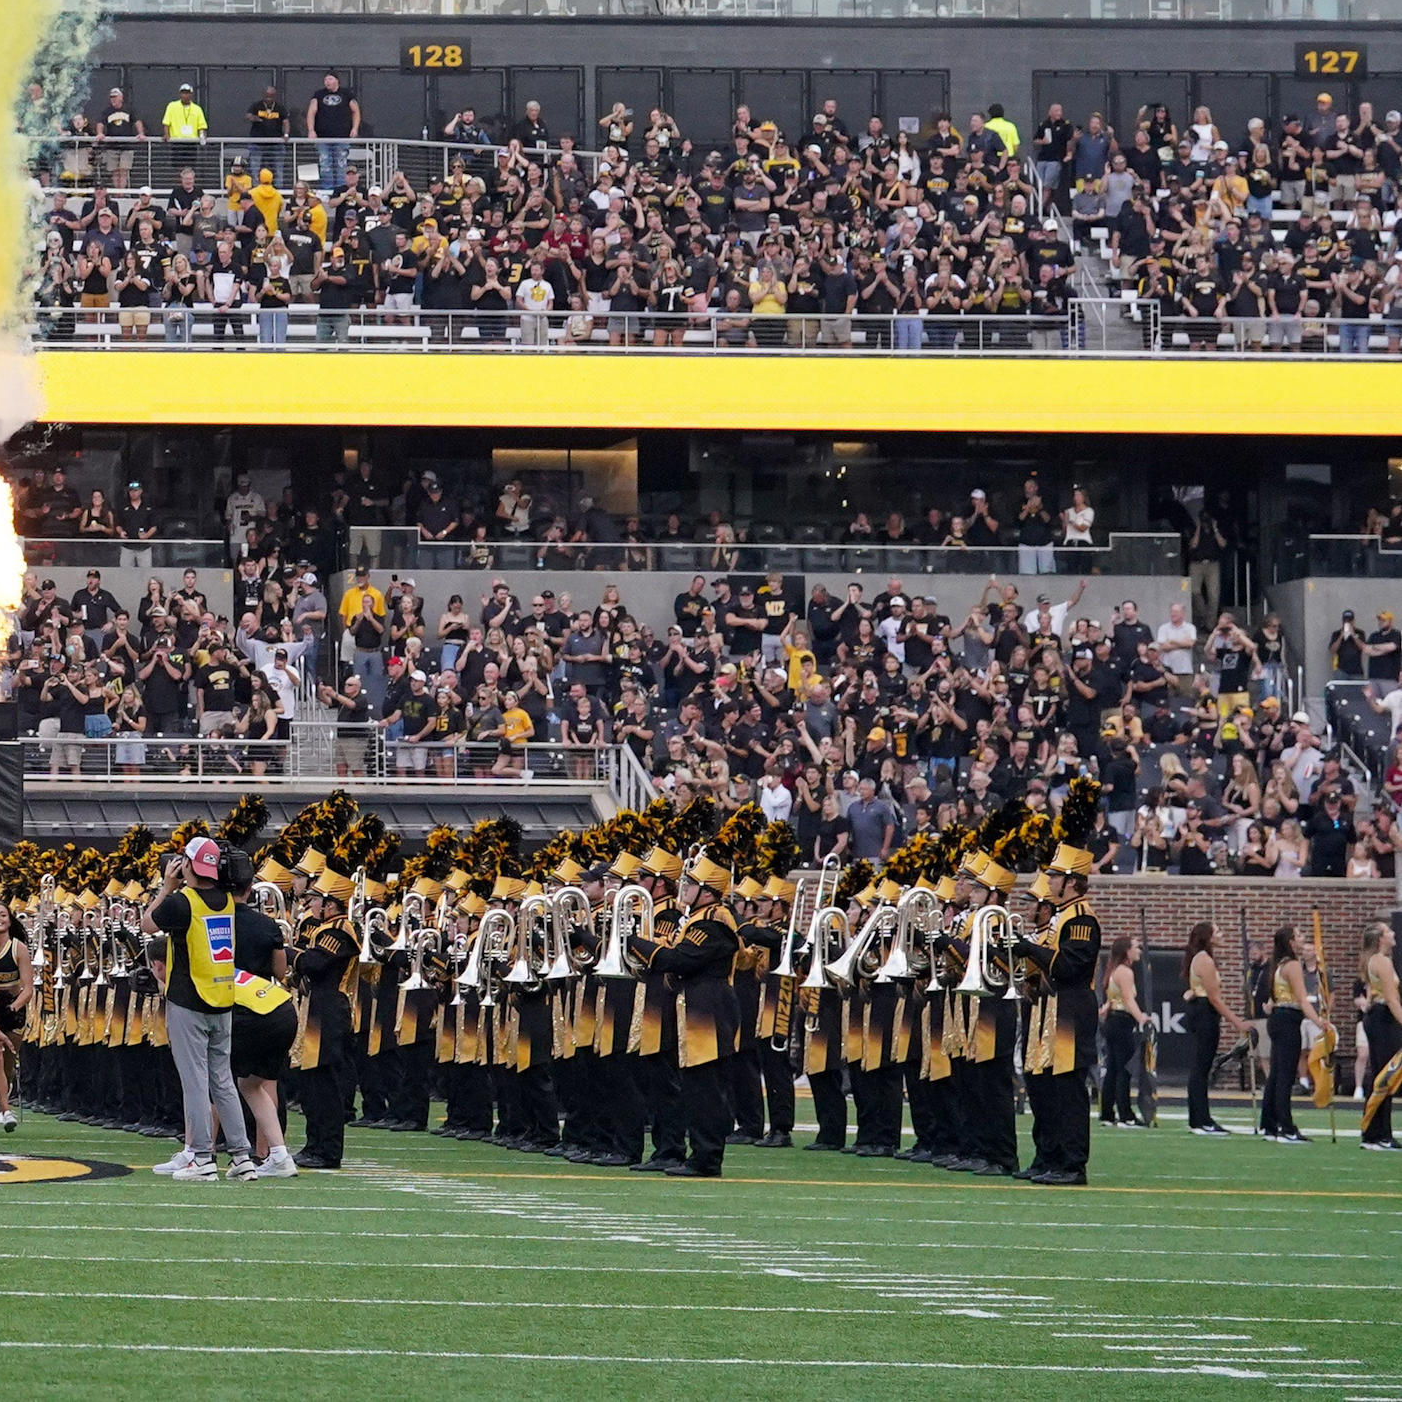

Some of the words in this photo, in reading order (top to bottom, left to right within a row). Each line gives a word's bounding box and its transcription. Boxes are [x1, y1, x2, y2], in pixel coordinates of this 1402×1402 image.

[408, 45, 462, 68] 128
[1304, 51, 1358, 74] 127
[508, 264, 523, 282] 3
[775, 977, 793, 1036] MIZZO
